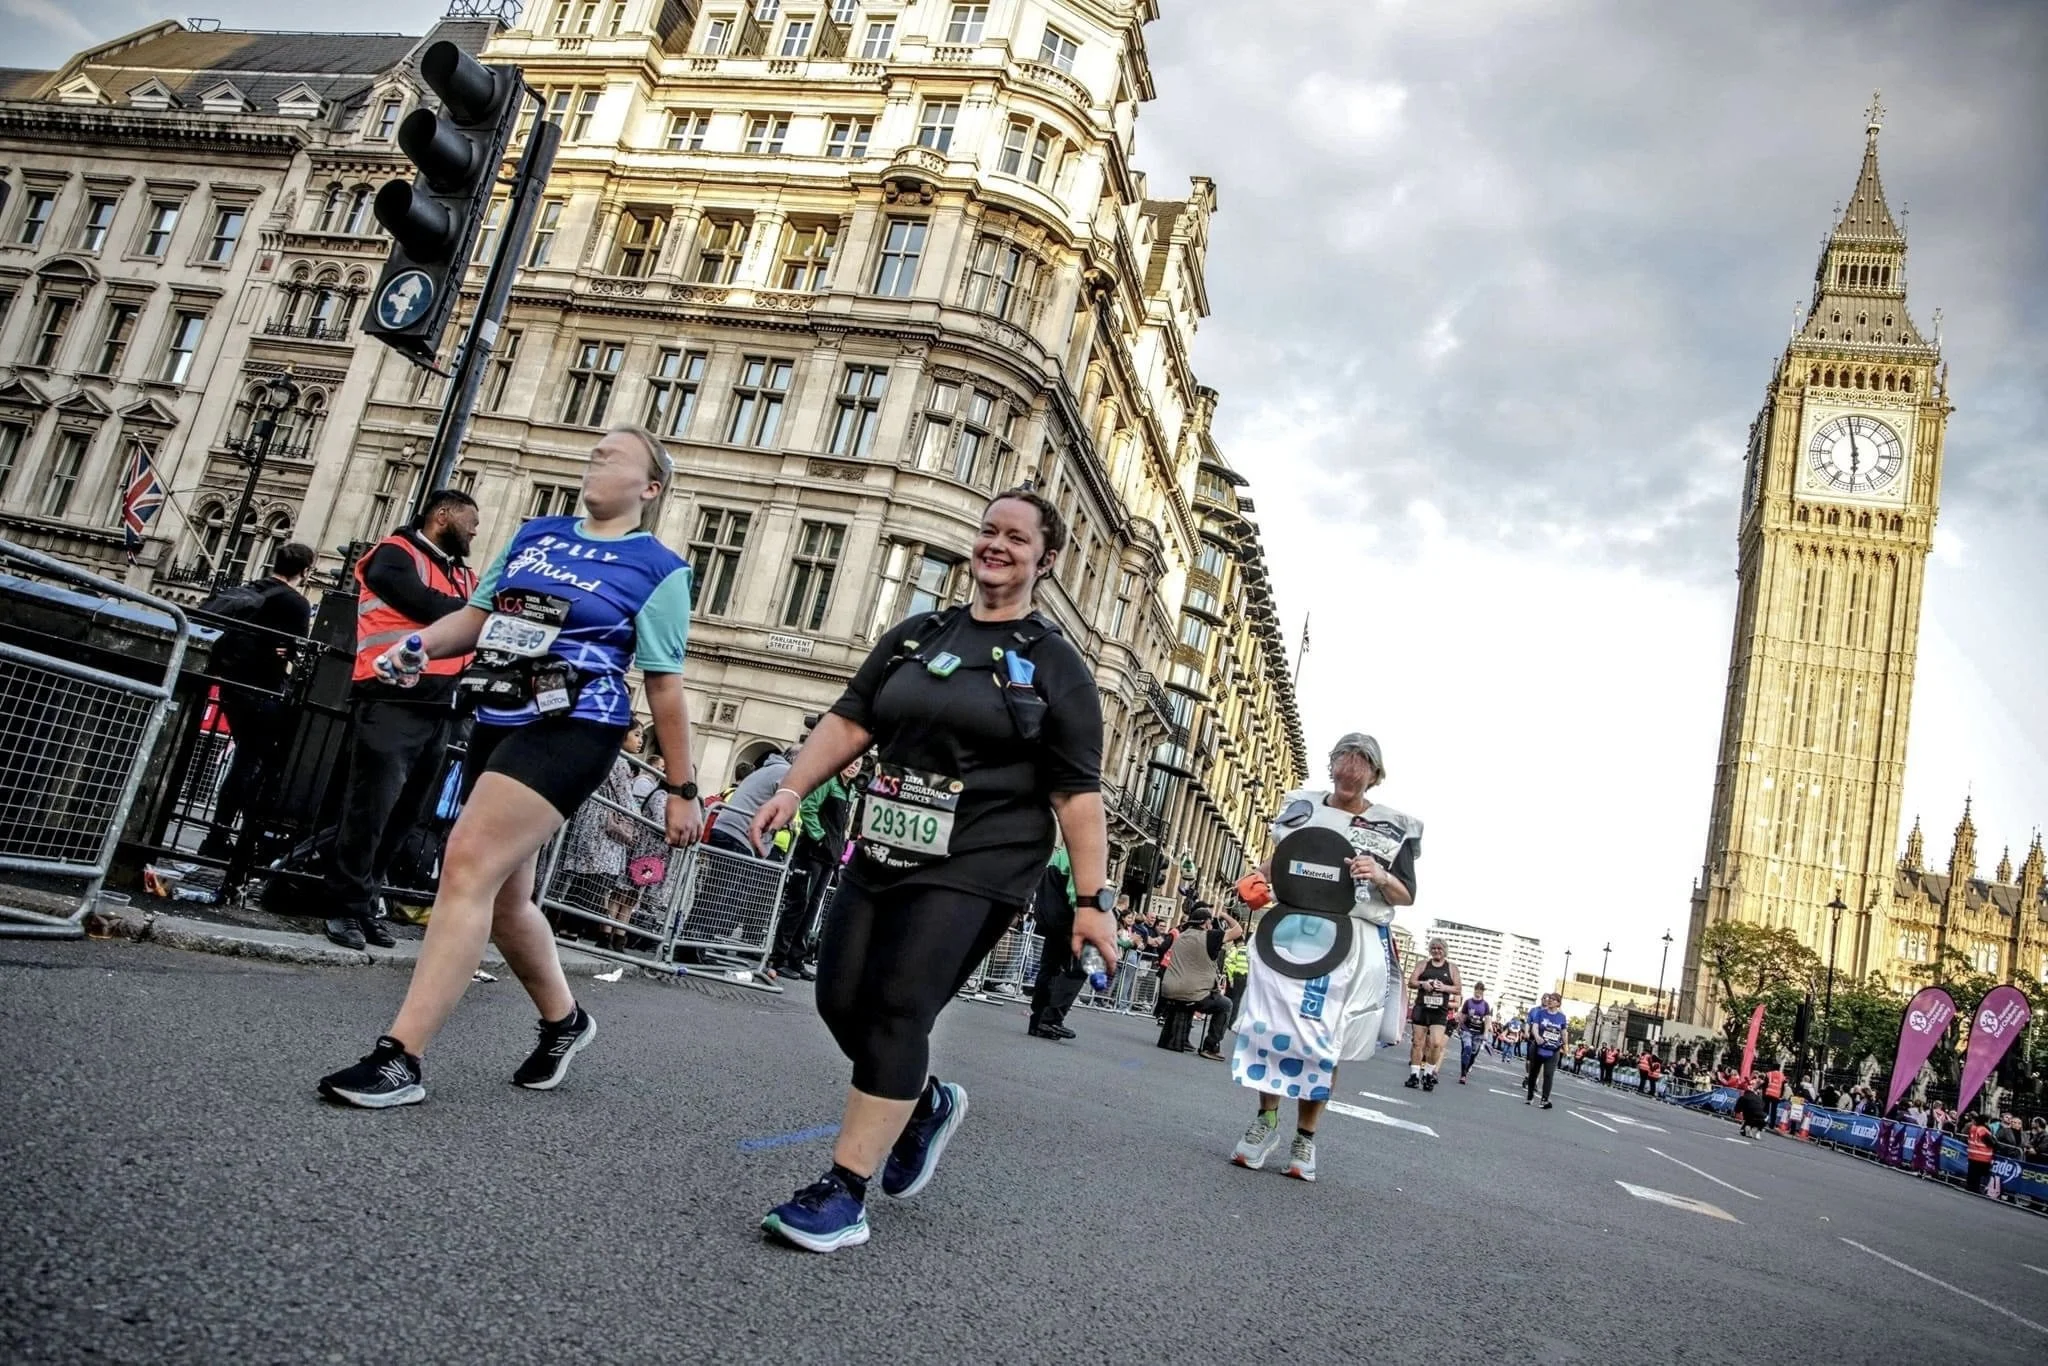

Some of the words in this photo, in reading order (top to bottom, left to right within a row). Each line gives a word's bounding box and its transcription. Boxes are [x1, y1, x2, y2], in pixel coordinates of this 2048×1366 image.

[537, 535, 619, 562] HOLLY
[527, 558, 602, 593] mind
[769, 641, 794, 650] STREET
[770, 635, 811, 647] PARLIAMENT
[904, 775, 924, 786] TATA
[899, 791, 931, 804] SERVICES
[901, 782, 952, 801] CONSULTANCY
[870, 804, 938, 844] 29319
[1302, 868, 1334, 880] WaterAid
